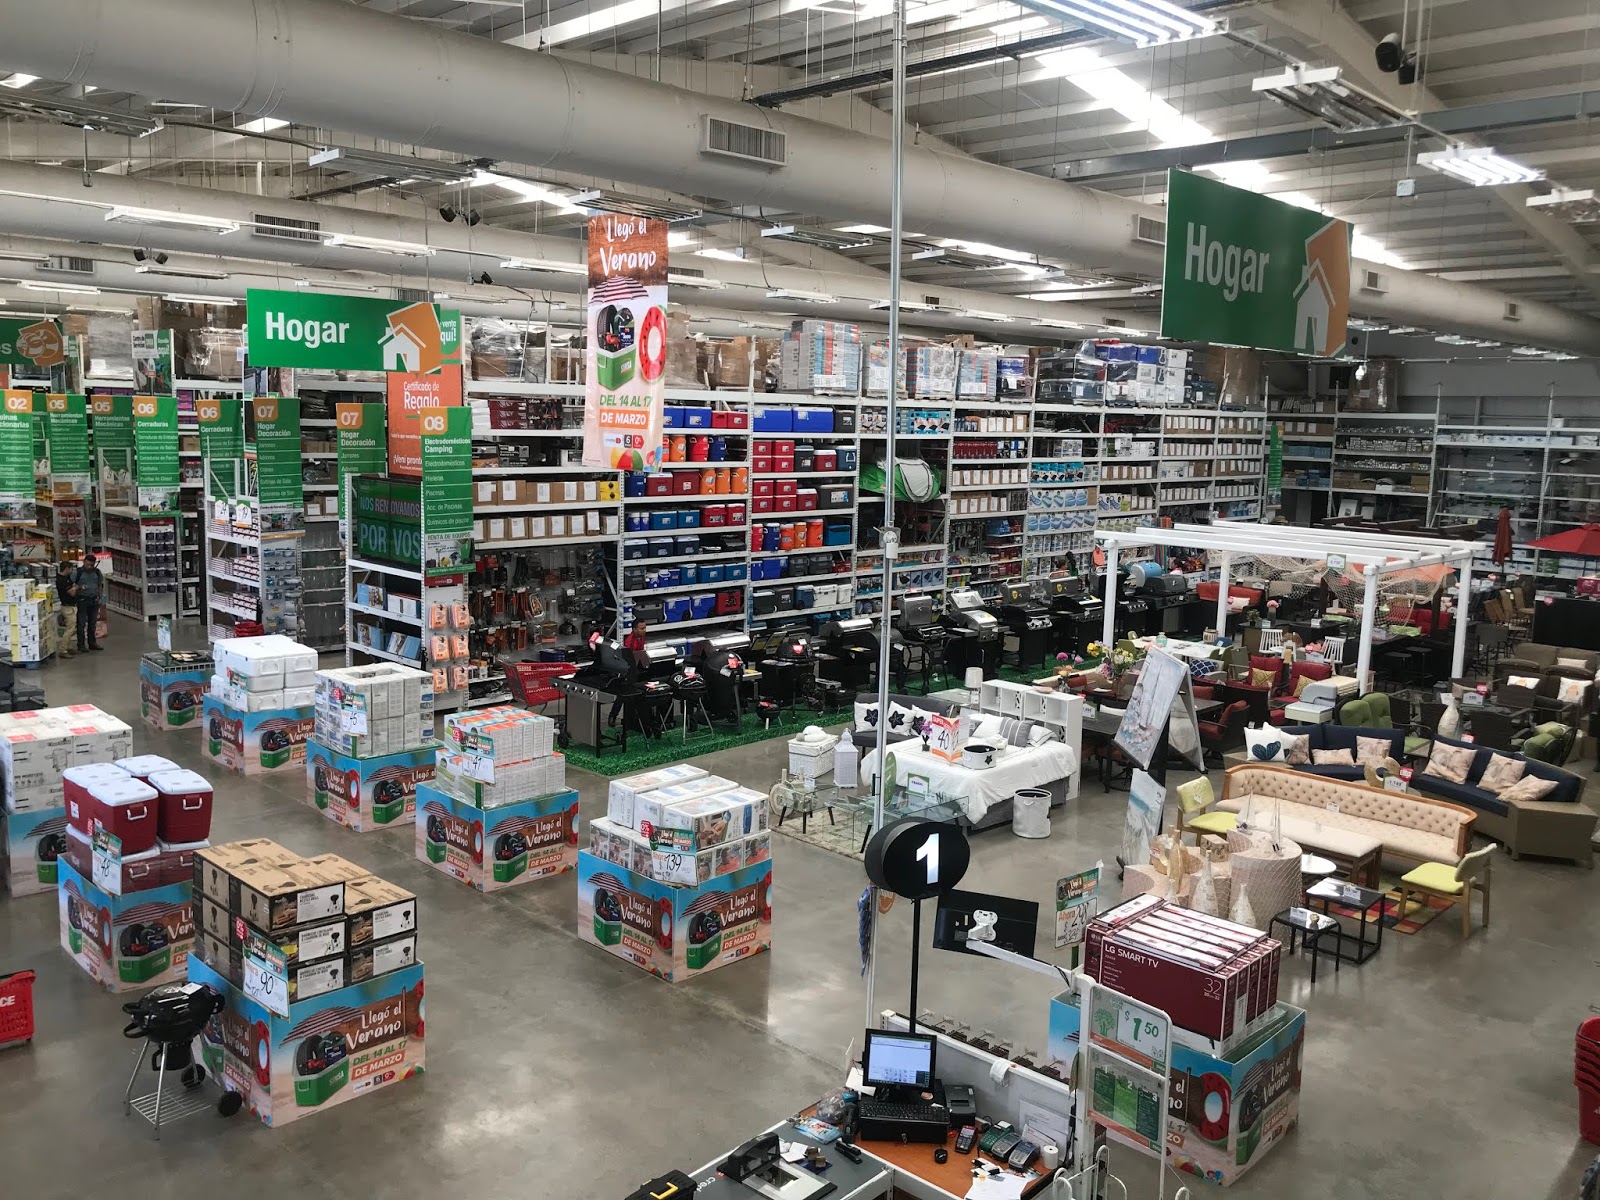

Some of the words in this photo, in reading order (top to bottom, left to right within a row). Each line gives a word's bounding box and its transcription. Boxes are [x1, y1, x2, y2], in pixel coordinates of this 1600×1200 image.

[607, 216, 635, 242] Llegó
[638, 218, 647, 234] el
[599, 247, 657, 276] Verano
[1185, 221, 1270, 302] Hogar
[265, 311, 350, 349] Hogar
[440, 330, 457, 346] quí!
[403, 381, 431, 392] Certificado
[432, 382, 440, 391] de
[7, 398, 27, 410] 02
[49, 400, 65, 410] 05
[94, 402, 111, 413] 05
[404, 392, 440, 414] Regalo
[599, 394, 617, 406] DEL
[619, 395, 628, 407] 14
[630, 396, 641, 407] AL
[137, 403, 155, 414] 06
[200, 407, 218, 419] 06
[257, 406, 275, 418] 07
[340, 412, 359, 426] 07
[423, 416, 445, 431] 08
[600, 412, 613, 424] DE
[615, 413, 647, 425] MARZO
[257, 423, 275, 431] Hogar
[341, 431, 359, 439] Hogar
[341, 438, 376, 446] Decoración
[424, 445, 453, 454] Camping
[425, 459, 466, 467] Electrodomésticos
[360, 497, 374, 511] NOS
[361, 523, 387, 553] POR
[393, 528, 420, 560] VOS
[427, 533, 444, 541] RENTA
[452, 531, 471, 540] EQUIPOS
[20, 545, 36, 557] 27
[289, 731, 315, 743] Veran
[411, 770, 429, 782] Llegó
[451, 820, 464, 833] Llegó
[535, 820, 555, 834] Llegó
[556, 817, 562, 827] el
[445, 827, 469, 847] Verano
[525, 830, 562, 848] Verano
[539, 855, 562, 865] MARZO
[915, 833, 940, 884] 1
[628, 896, 645, 914] Llegó
[646, 904, 652, 916] el
[730, 893, 749, 910] Llegó
[750, 889, 757, 901] el
[620, 903, 652, 929] Verano
[720, 904, 756, 927] Verano
[623, 928, 634, 937] DEL
[723, 931, 735, 940] DEL
[732, 933, 755, 946] MARZO
[623, 938, 631, 946] DE
[631, 941, 651, 955] MARZO
[1104, 944, 1116, 954] LG
[1117, 948, 1146, 964] SMART
[1147, 957, 1160, 968] TV
[260, 971, 274, 995] 90
[1203, 977, 1222, 997] 32
[0, 995, 16, 1007] CE
[361, 1006, 390, 1029] Llegó
[393, 1000, 402, 1015] el
[1124, 1010, 1131, 1022] $
[1144, 1021, 1159, 1038] 50
[345, 1020, 401, 1050] Verano
[353, 1056, 369, 1066] DEL
[373, 1050, 382, 1058] 14
[384, 1046, 396, 1055] AL
[398, 1040, 407, 1049] 17
[354, 1068, 367, 1077] DE
[369, 1053, 402, 1070] MARZO
[1127, 1080, 1133, 1090] 2
[1175, 1079, 1185, 1094] el
[1151, 1091, 1158, 1102] 3
